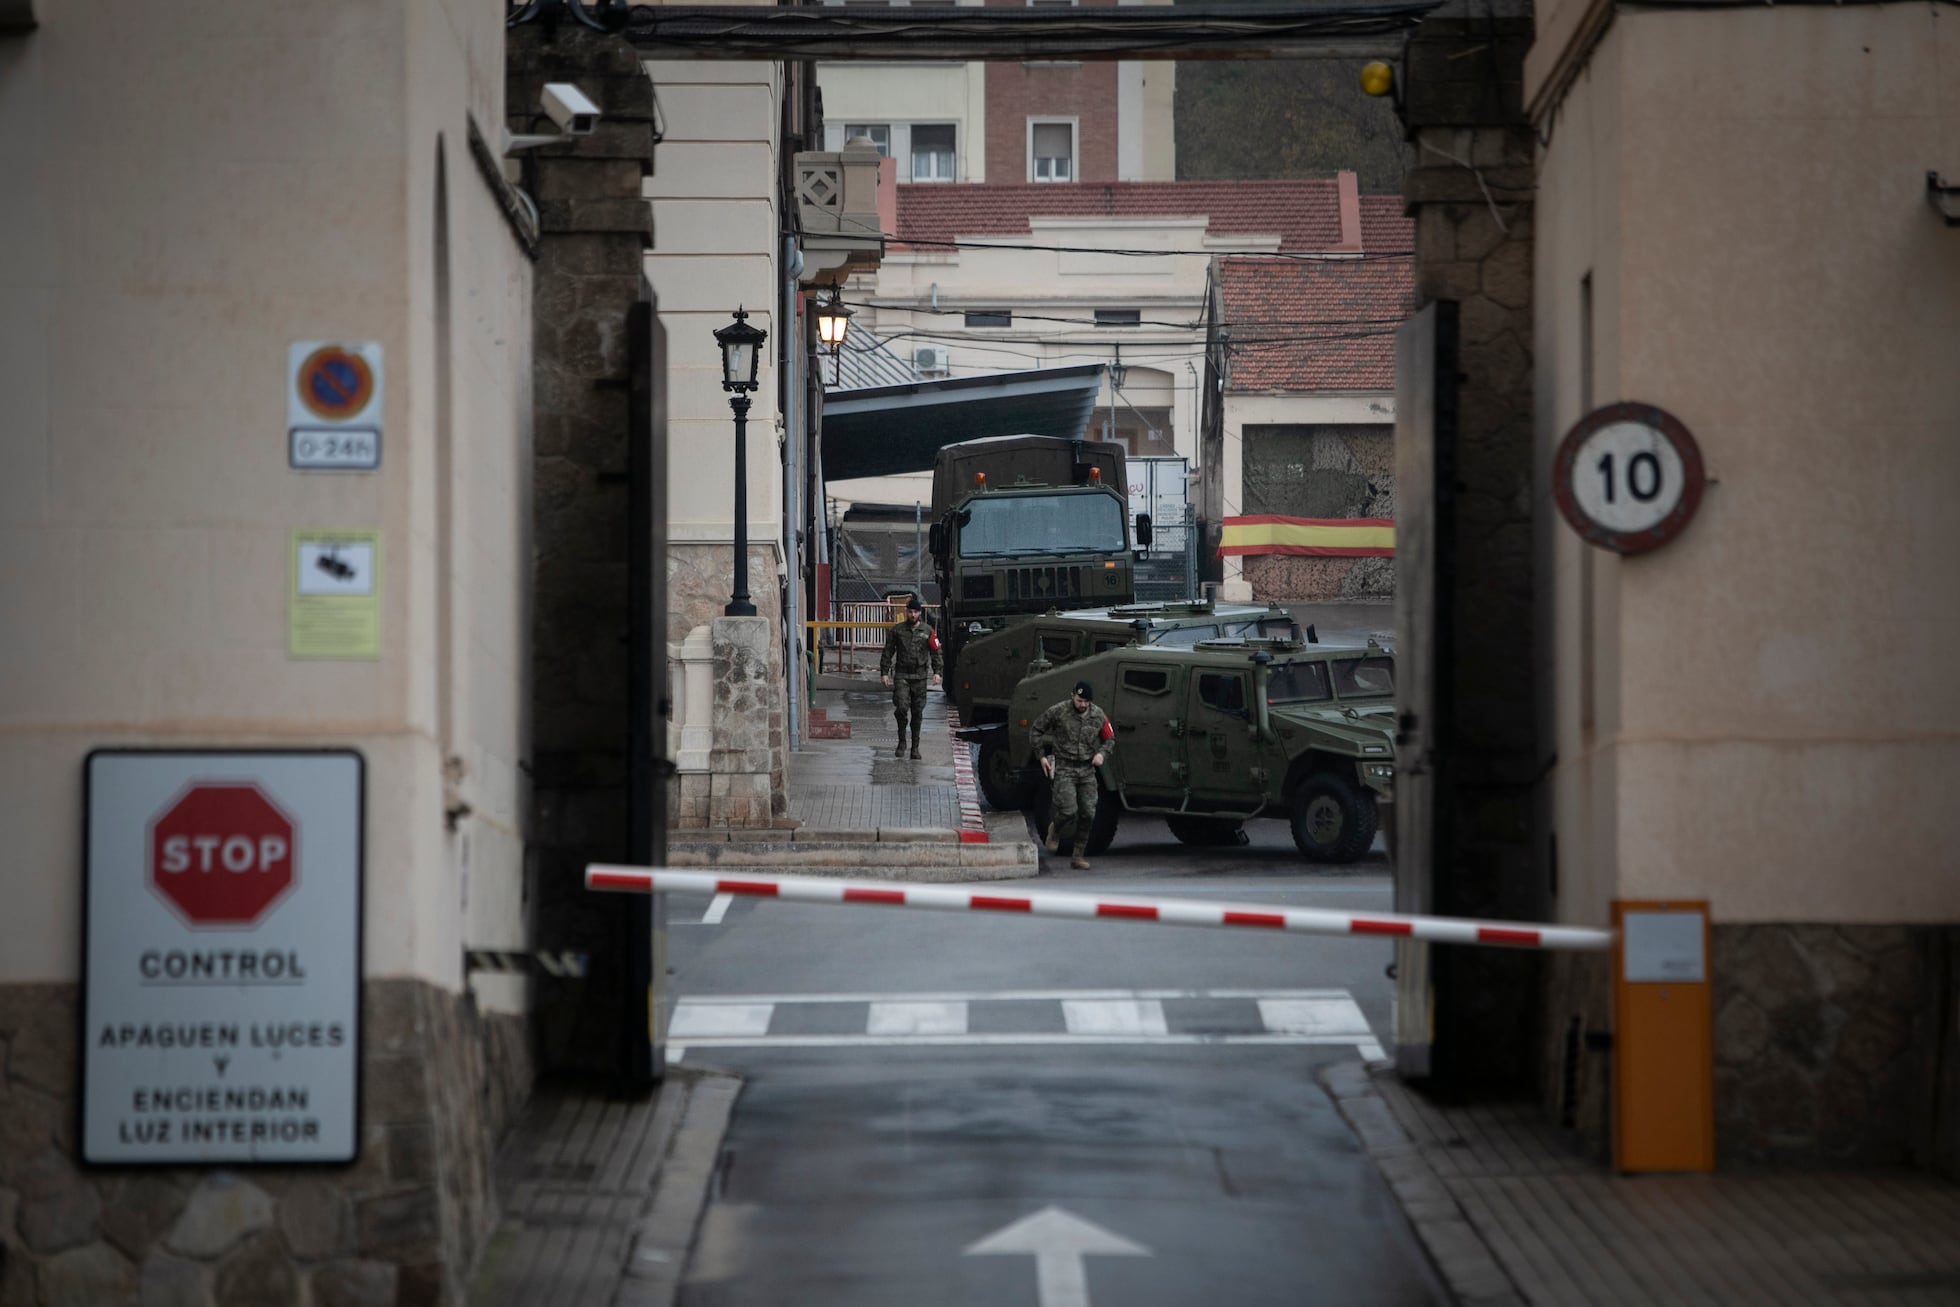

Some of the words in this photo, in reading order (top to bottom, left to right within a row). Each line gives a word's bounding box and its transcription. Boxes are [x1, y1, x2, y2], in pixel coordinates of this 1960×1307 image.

[1598, 452, 1662, 503] 10
[1105, 575, 1117, 585] 16
[161, 836, 288, 873] STOP
[140, 952, 306, 979] CONTROL
[100, 1024, 239, 1049] APAGUEN
[250, 1023, 345, 1048] LUCES
[212, 1056, 229, 1079] Y
[133, 1089, 309, 1112] ENCIENDAN
[119, 1121, 171, 1144] LUZ
[183, 1121, 320, 1143] INTERIOR
